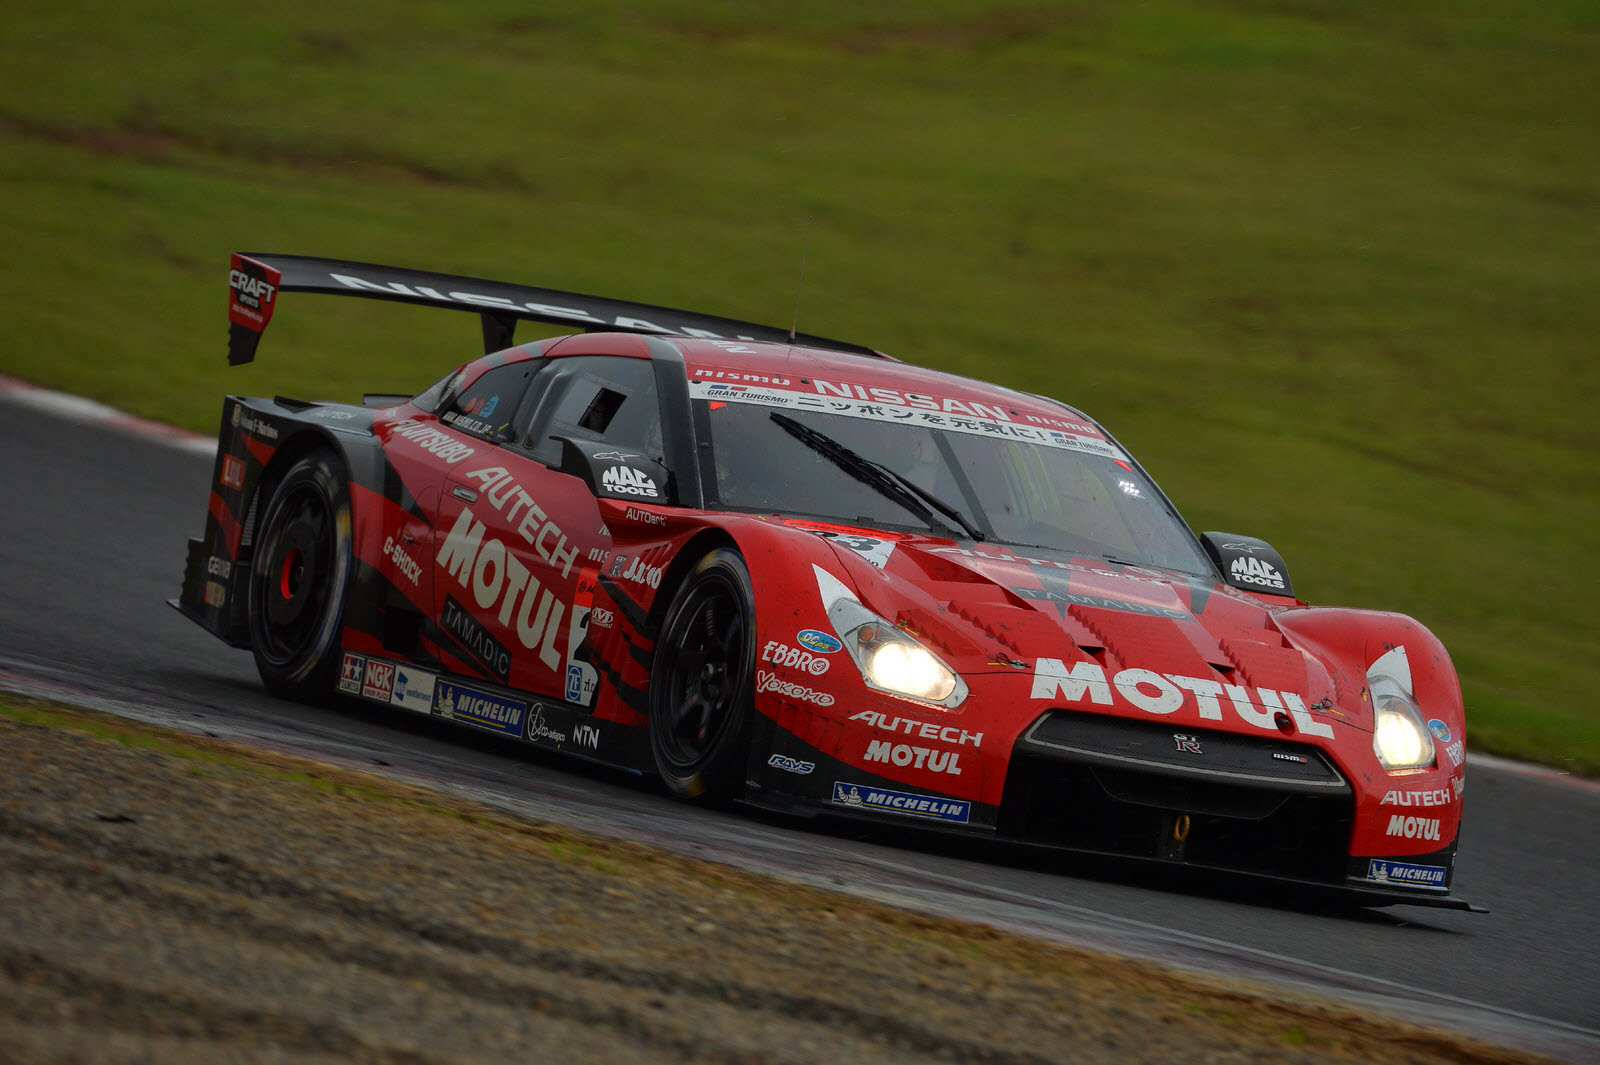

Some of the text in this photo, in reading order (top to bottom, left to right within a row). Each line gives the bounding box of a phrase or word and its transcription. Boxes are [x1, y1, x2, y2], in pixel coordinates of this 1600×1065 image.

[230, 269, 276, 303] CRAFT
[695, 369, 791, 386] nismo
[707, 389, 738, 397] GRAN
[741, 392, 788, 403] TURISMO
[813, 379, 1012, 422] NISSAN
[1026, 414, 1097, 434] nismo
[384, 419, 475, 464] FUJITSUBO
[1054, 437, 1077, 447] GRAN
[602, 466, 657, 489] MAC
[603, 483, 659, 497] TOOLS
[466, 466, 581, 579] AUTECH
[383, 535, 423, 587] G-SHOCK
[1231, 556, 1283, 581] MAC
[436, 507, 566, 673] MOTUL
[1232, 573, 1285, 589] TOOLS
[1017, 588, 1187, 619] TAMADIC
[446, 601, 509, 675] TAMADIC
[761, 640, 830, 676] EBBRO
[340, 679, 359, 693] TAMIYA
[365, 663, 393, 692] NGK
[364, 687, 375, 697] SPARK
[1030, 657, 1335, 740] MOTUL
[457, 693, 521, 726] MICHELIN
[573, 724, 600, 750] NTN
[848, 710, 984, 748] AUTECH
[768, 754, 816, 773] RAYS
[863, 739, 962, 776] MOTUL
[1273, 752, 1307, 764] nismo
[866, 791, 964, 817] MICHELIN
[1380, 787, 1451, 806] AUTECH
[1386, 814, 1441, 841] MOTUL
[1390, 866, 1444, 882] MICHELIN
